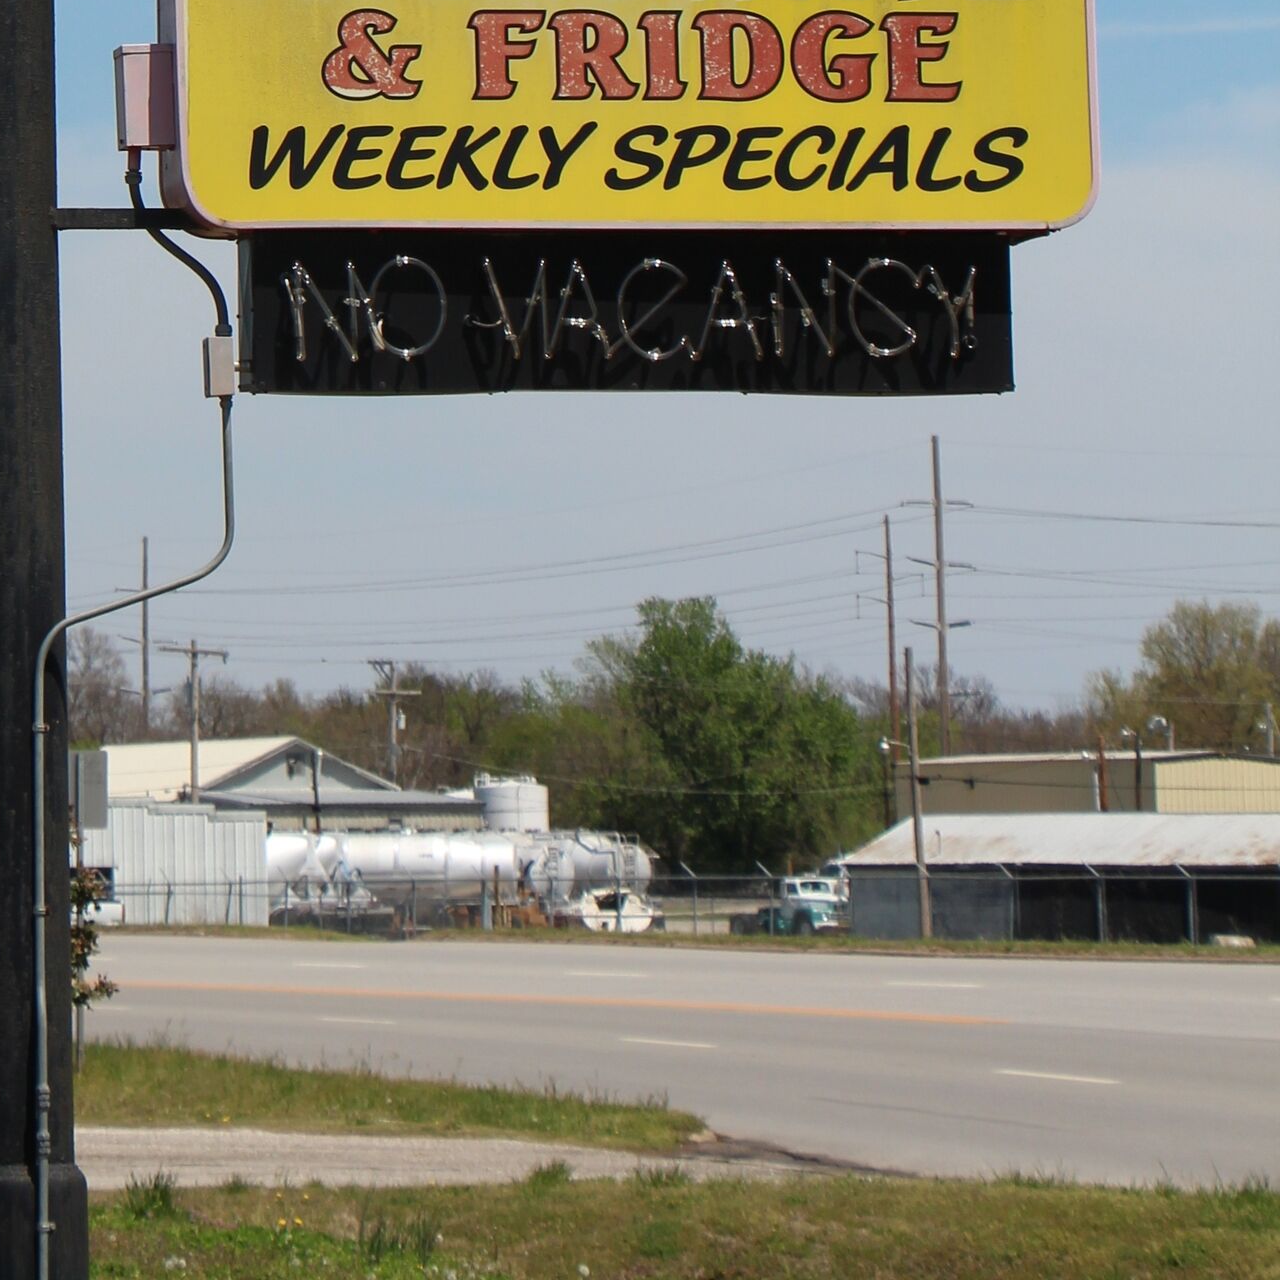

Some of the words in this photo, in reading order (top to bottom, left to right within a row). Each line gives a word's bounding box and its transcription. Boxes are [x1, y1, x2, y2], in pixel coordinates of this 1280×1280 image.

[321, 8, 423, 101] &
[466, 9, 963, 103] FRIDGE
[249, 121, 598, 191] WEEKLY
[604, 125, 1028, 192] SPECIALS
[282, 255, 449, 360] NO
[463, 257, 977, 361] VACANCY
